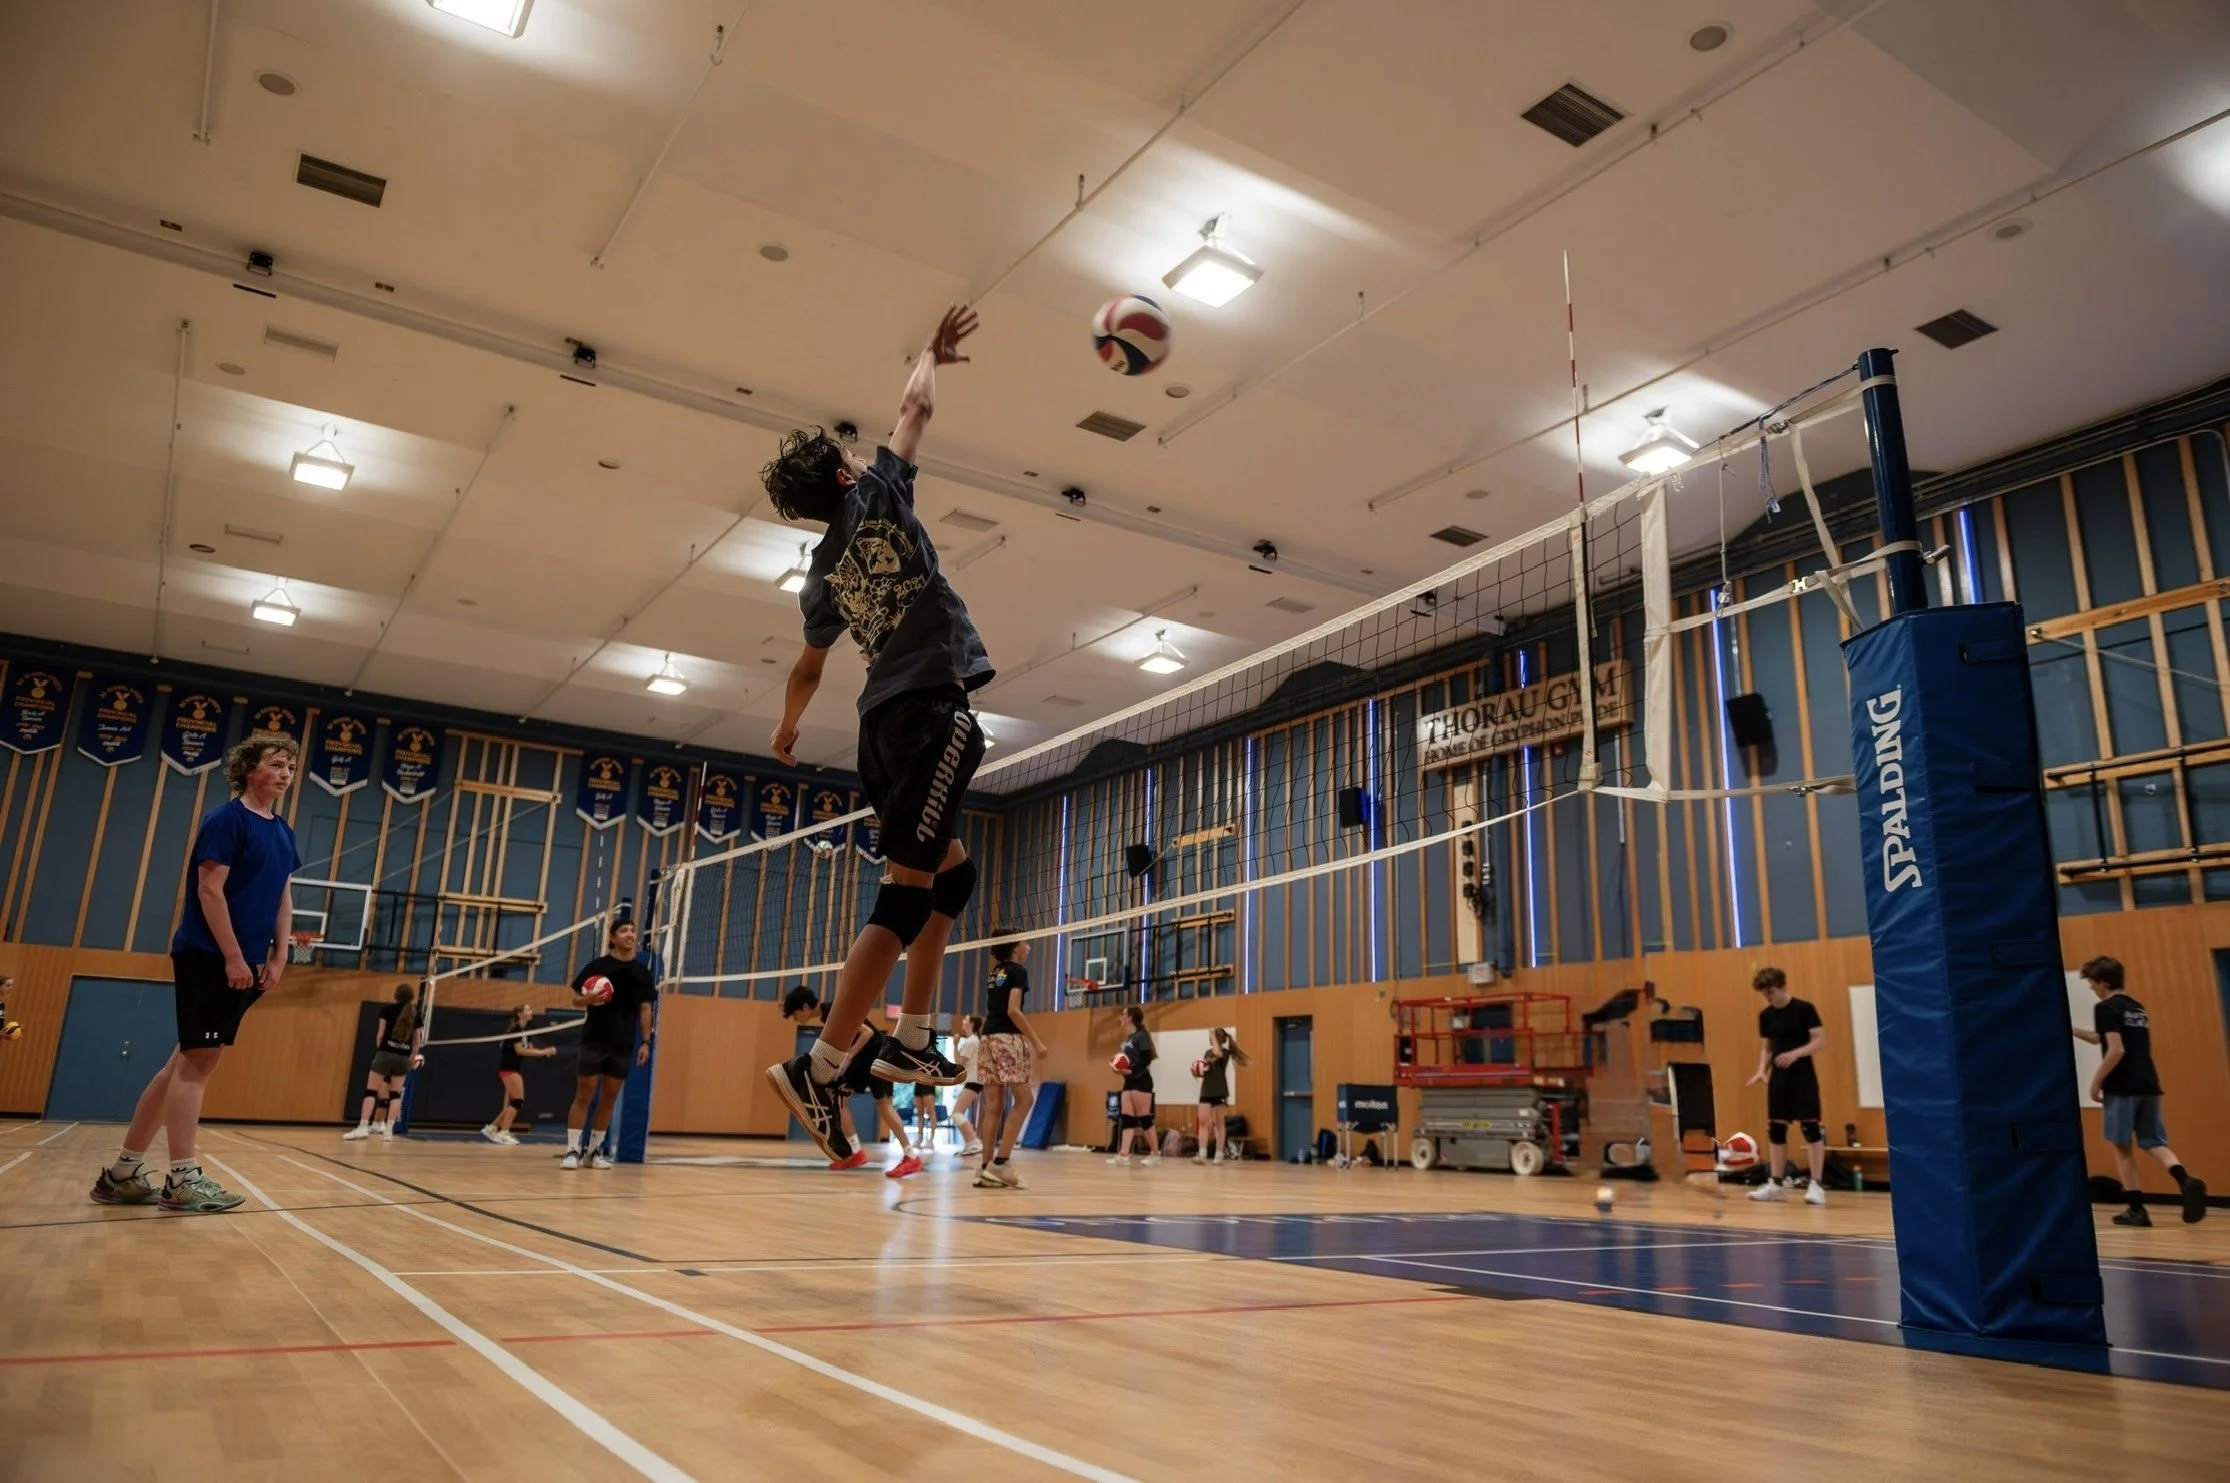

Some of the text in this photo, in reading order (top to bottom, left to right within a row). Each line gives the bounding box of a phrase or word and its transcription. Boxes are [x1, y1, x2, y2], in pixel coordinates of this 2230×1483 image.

[893, 574, 926, 599] 2021
[1425, 689, 1539, 744] THORAU
[1571, 701, 1619, 726] PDE
[1866, 687, 1922, 893] SPALDING
[1354, 1099, 1389, 1110] molten
